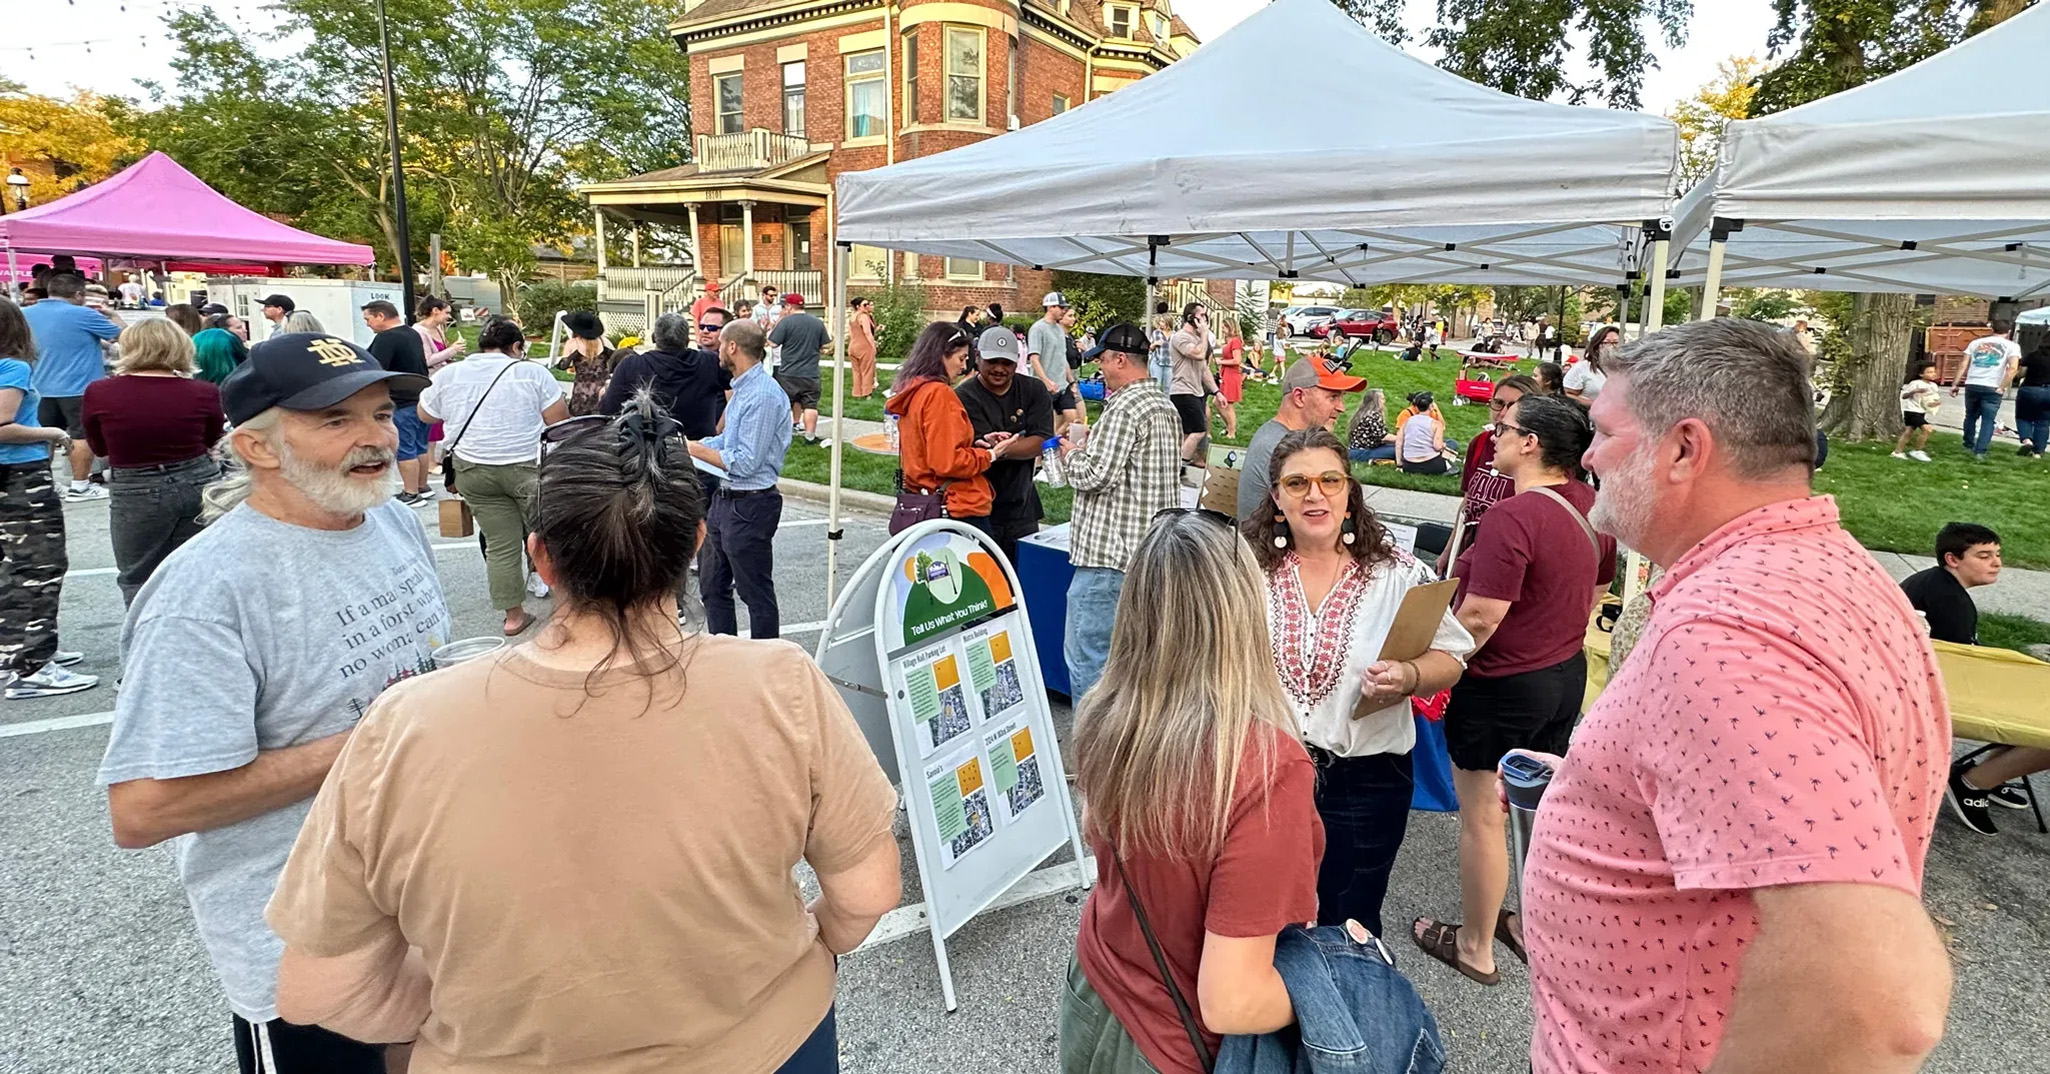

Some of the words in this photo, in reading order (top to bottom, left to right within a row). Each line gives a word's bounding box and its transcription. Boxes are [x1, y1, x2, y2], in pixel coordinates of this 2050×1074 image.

[370, 292, 390, 300] LOOK
[336, 604, 357, 627] If
[358, 605, 371, 617] a
[370, 590, 397, 610] ma
[911, 625, 925, 635] Tell
[925, 620, 935, 631] Us
[935, 614, 955, 626] What
[954, 608, 968, 619] You
[968, 600, 988, 613] Think!
[340, 657, 367, 679] no
[415, 612, 440, 634] can
[342, 632, 367, 650] in
[369, 624, 381, 637] a
